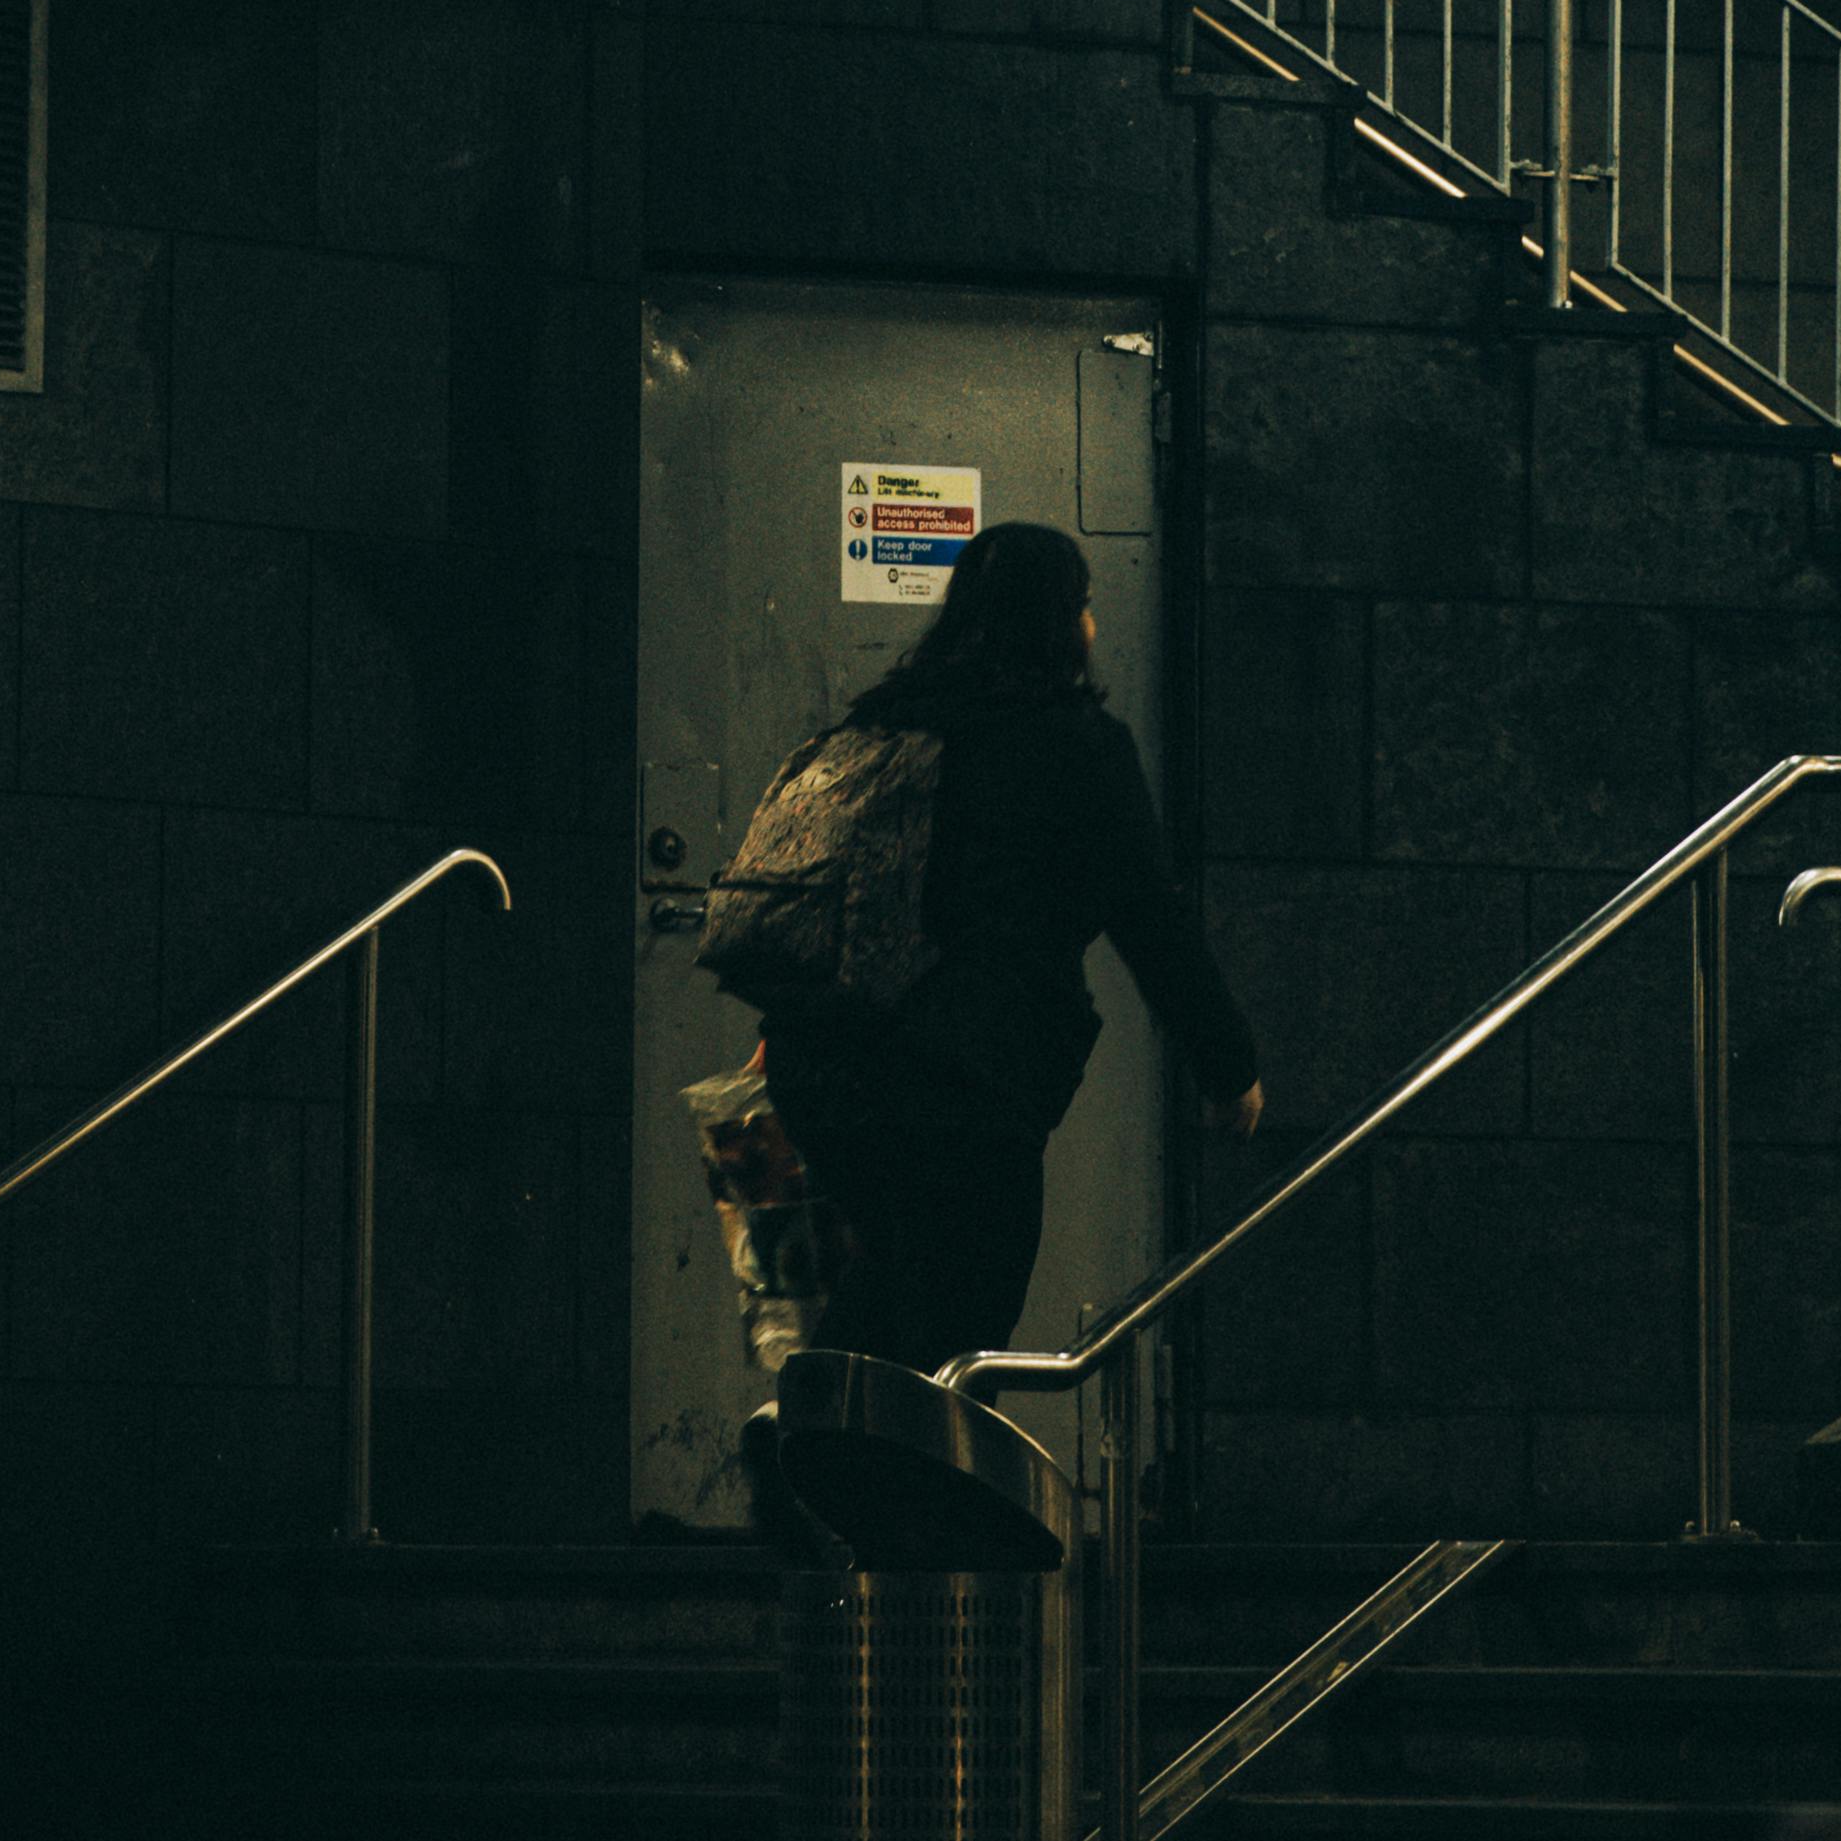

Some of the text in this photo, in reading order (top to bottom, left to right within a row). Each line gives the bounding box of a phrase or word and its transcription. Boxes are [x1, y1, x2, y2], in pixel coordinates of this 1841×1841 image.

[877, 475, 920, 488] Danger
[877, 507, 945, 519] Unauthorised
[877, 520, 971, 532] access prohibited
[877, 540, 932, 550] Keep door
[877, 551, 913, 561] locked
